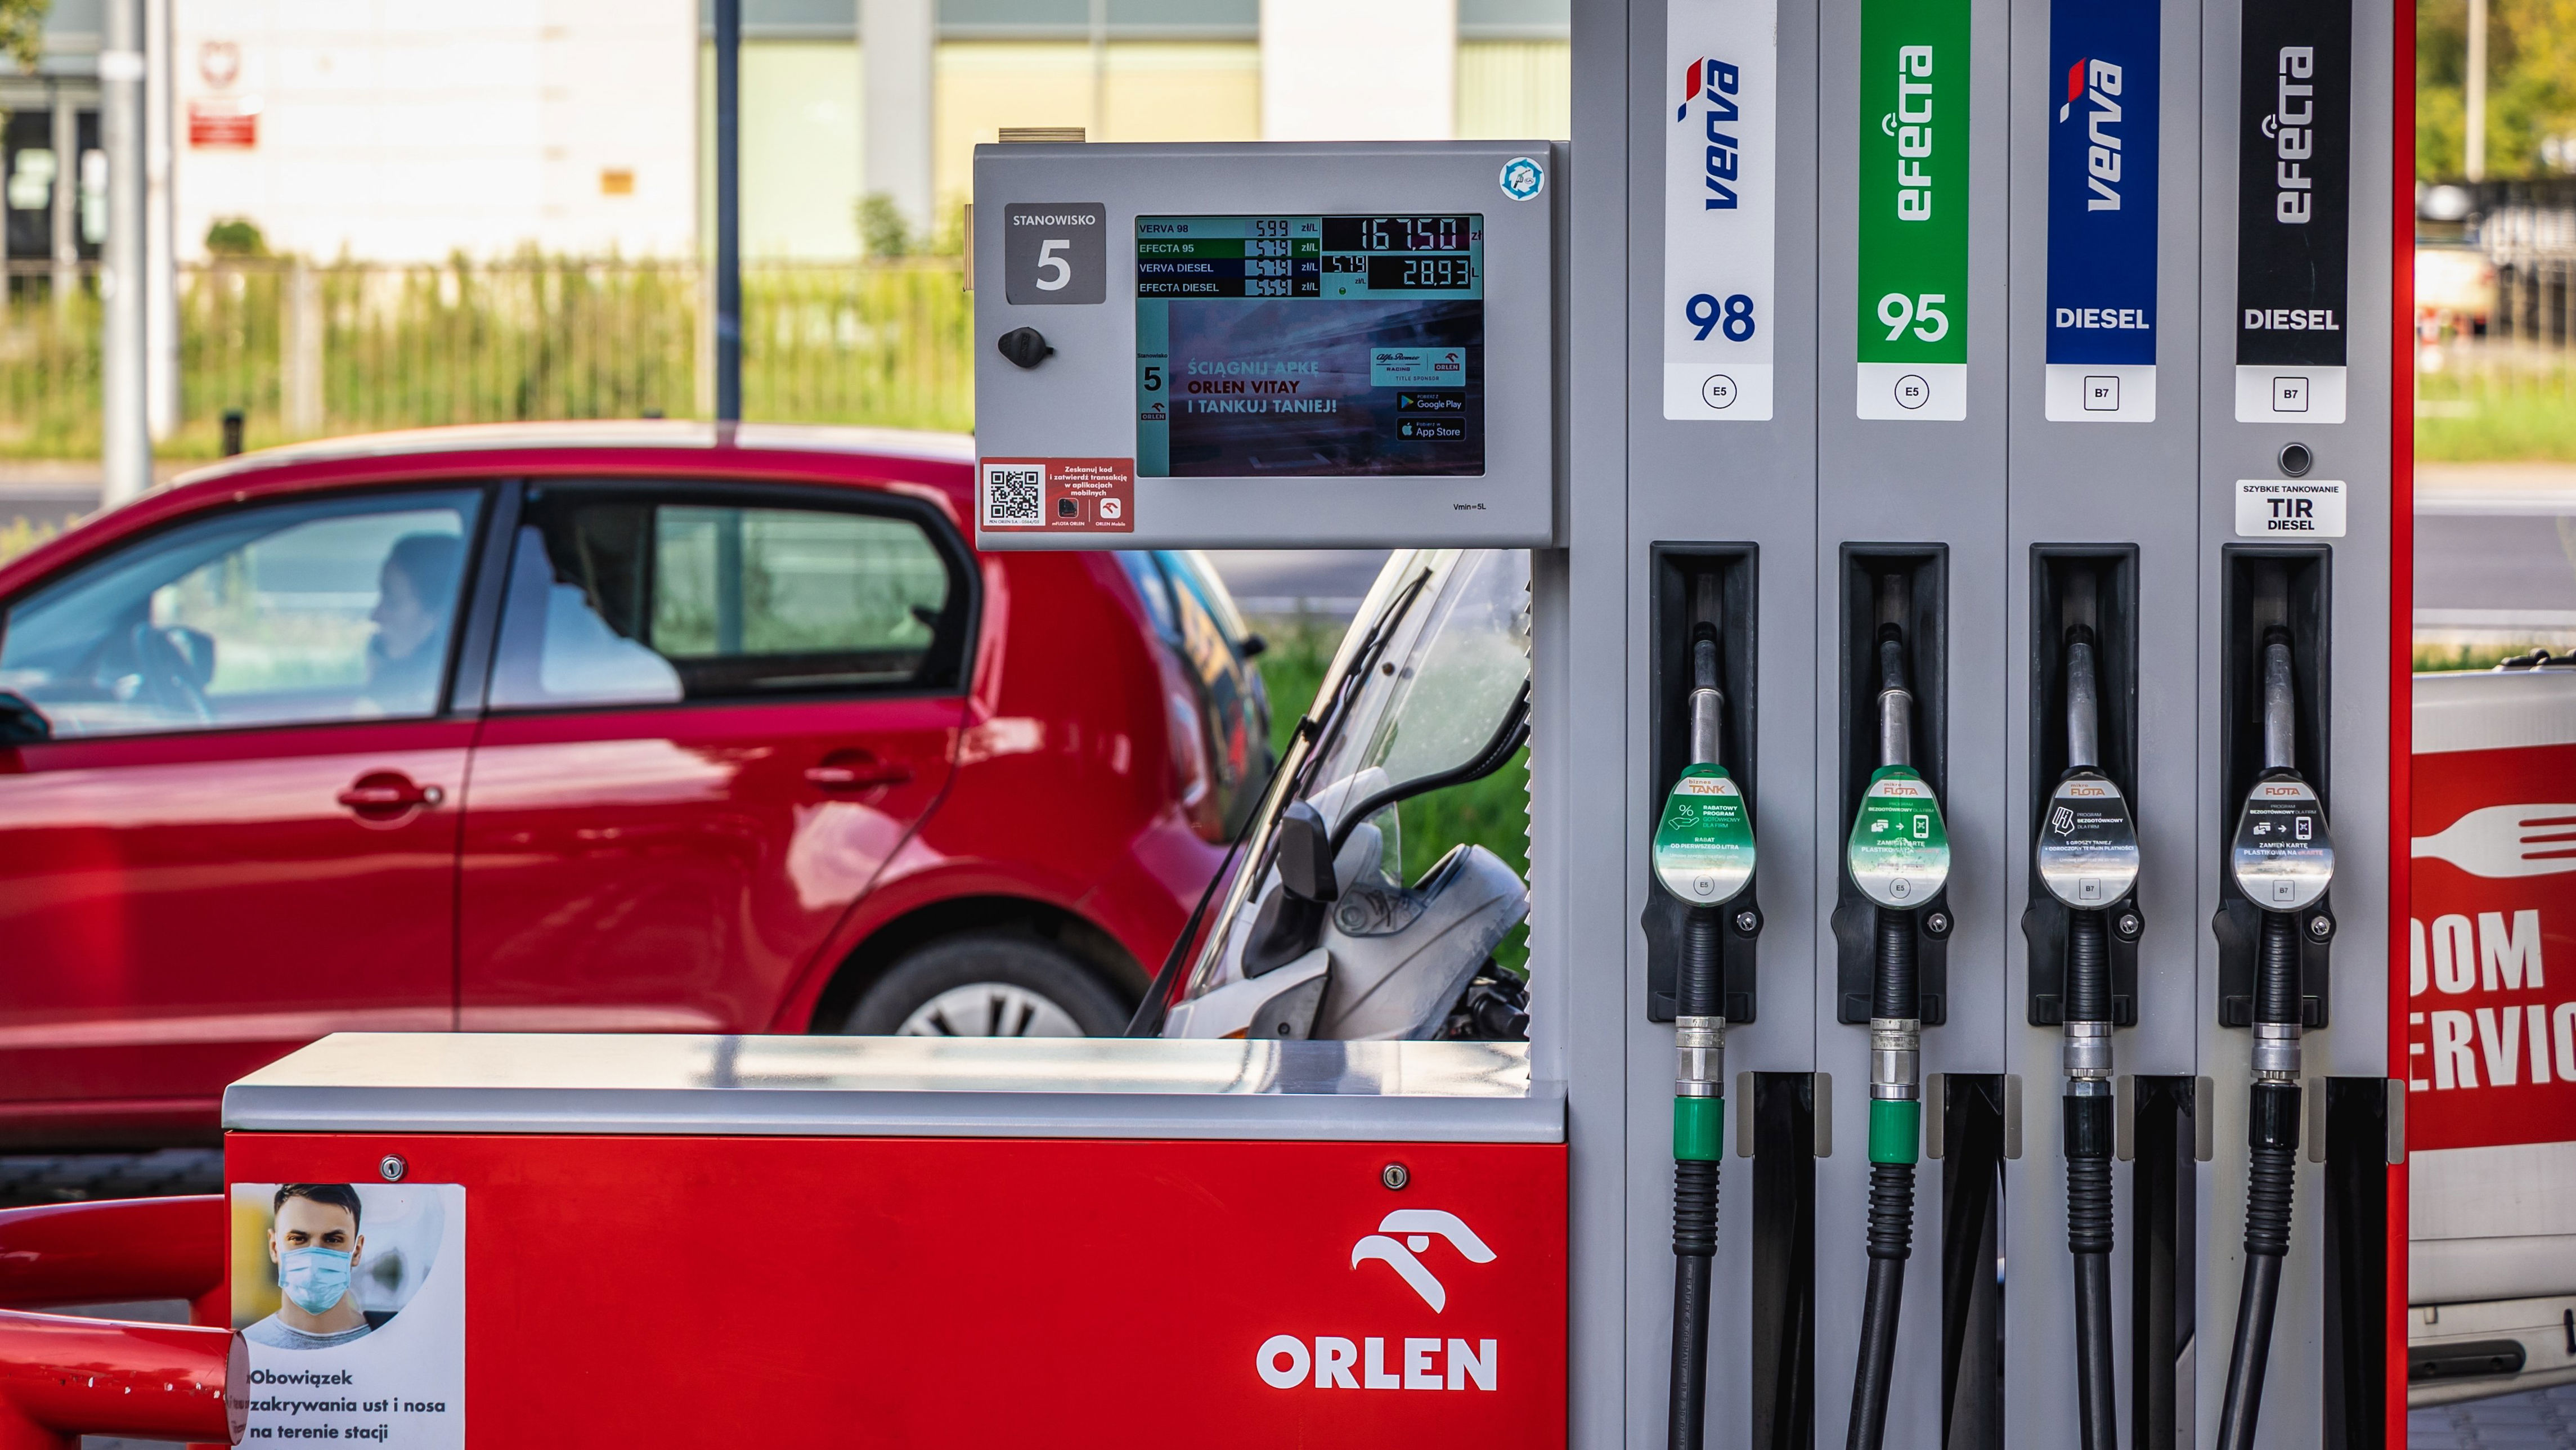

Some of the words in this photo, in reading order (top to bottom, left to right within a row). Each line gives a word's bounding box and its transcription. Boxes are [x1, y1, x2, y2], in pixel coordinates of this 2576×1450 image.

[1013, 215, 1096, 226] STANOWISKO
[1139, 225, 1174, 233] VERVA
[1177, 225, 1188, 233] 98
[1301, 223, 1318, 232] zł/L
[1471, 230, 1482, 240] zł
[1139, 244, 1180, 253] EFECTA
[1182, 244, 1194, 253] 95
[1301, 244, 1318, 252] zł/L
[1036, 239, 1071, 290] 5
[1139, 264, 1174, 272] VERVA
[1177, 264, 1214, 272] DIESEL
[1471, 267, 1479, 277] L
[1139, 283, 1180, 292] EFECTA
[1182, 283, 1219, 292] DIESEL
[1686, 293, 1756, 342] 98
[1877, 293, 1949, 342] 95
[2056, 308, 2149, 330] DIESEL
[2244, 308, 2340, 331] DIESEL
[1187, 357, 1268, 378] ŚCIĄGNIJ
[1274, 361, 1320, 378] APKĘ
[1144, 366, 1162, 391] 5
[1187, 380, 1245, 394] ORLEN
[1251, 380, 1300, 394] VITAY
[1713, 387, 1727, 396] E5
[1905, 387, 1919, 397] E5
[2095, 388, 2109, 398] B7
[2283, 389, 2298, 399] B7
[1188, 399, 1193, 413] I
[1198, 399, 1267, 413] TANKUJ
[1272, 399, 1337, 413] TANIEJ!
[1417, 399, 1445, 410] Google
[1446, 399, 1462, 410] Play
[1416, 428, 1435, 438] App
[1437, 427, 1461, 437] Store
[2267, 498, 2313, 518] TIR
[2268, 520, 2315, 530] DIESEL
[1689, 785, 1725, 794] TANK
[1884, 787, 1918, 796] FLOTA
[1256, 1335, 1497, 1391] ORLEN
[250, 1370, 353, 1388] Obowiązek
[250, 1397, 357, 1416] zakrywania
[362, 1399, 388, 1413] ust
[393, 1398, 398, 1413] i
[403, 1401, 446, 1413] nosa
[250, 1427, 272, 1439] na
[277, 1424, 339, 1439] terenie
[344, 1424, 388, 1443] stacji
